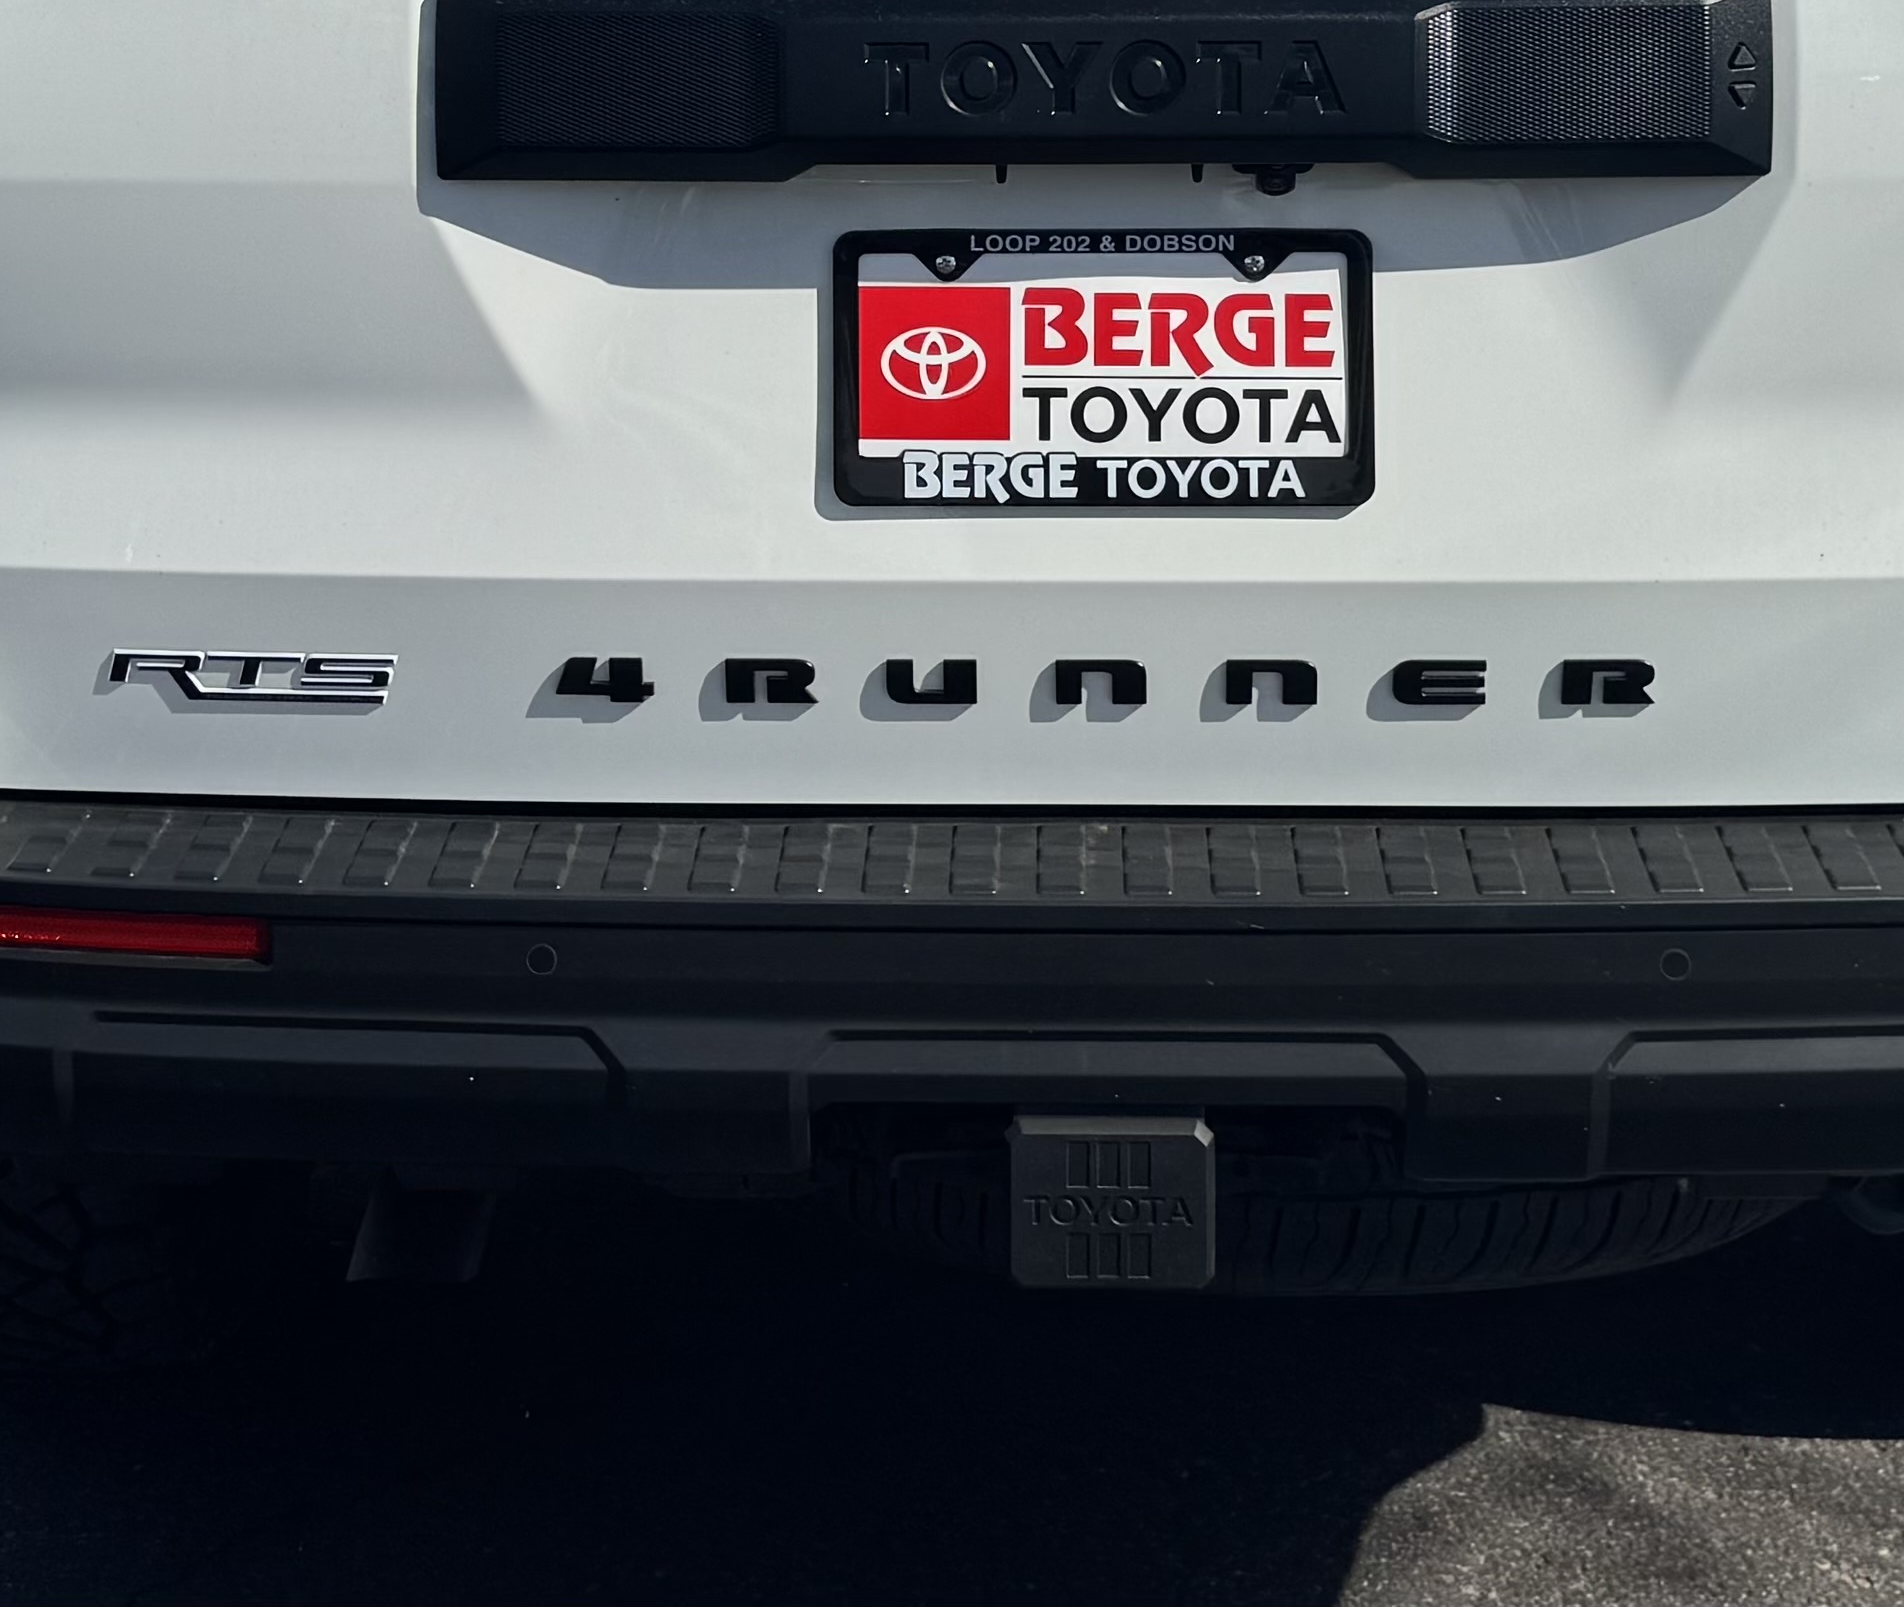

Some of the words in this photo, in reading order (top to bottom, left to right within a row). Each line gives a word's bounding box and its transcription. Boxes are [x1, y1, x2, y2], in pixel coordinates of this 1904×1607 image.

[862, 39, 1346, 117] TOYOTA
[969, 234, 1040, 252] LOOP
[1049, 234, 1090, 252] 202
[1099, 234, 1116, 252] &
[1125, 234, 1235, 252] DOBSON
[1021, 287, 1336, 378] BERGE
[1022, 387, 1342, 444] TOYOTA
[902, 451, 1078, 503] BERGE
[1096, 459, 1306, 499] TOYOTA
[109, 648, 398, 705] RTS
[555, 656, 1656, 705] 4RUNNER
[1023, 1197, 1193, 1226] TOYOTA
